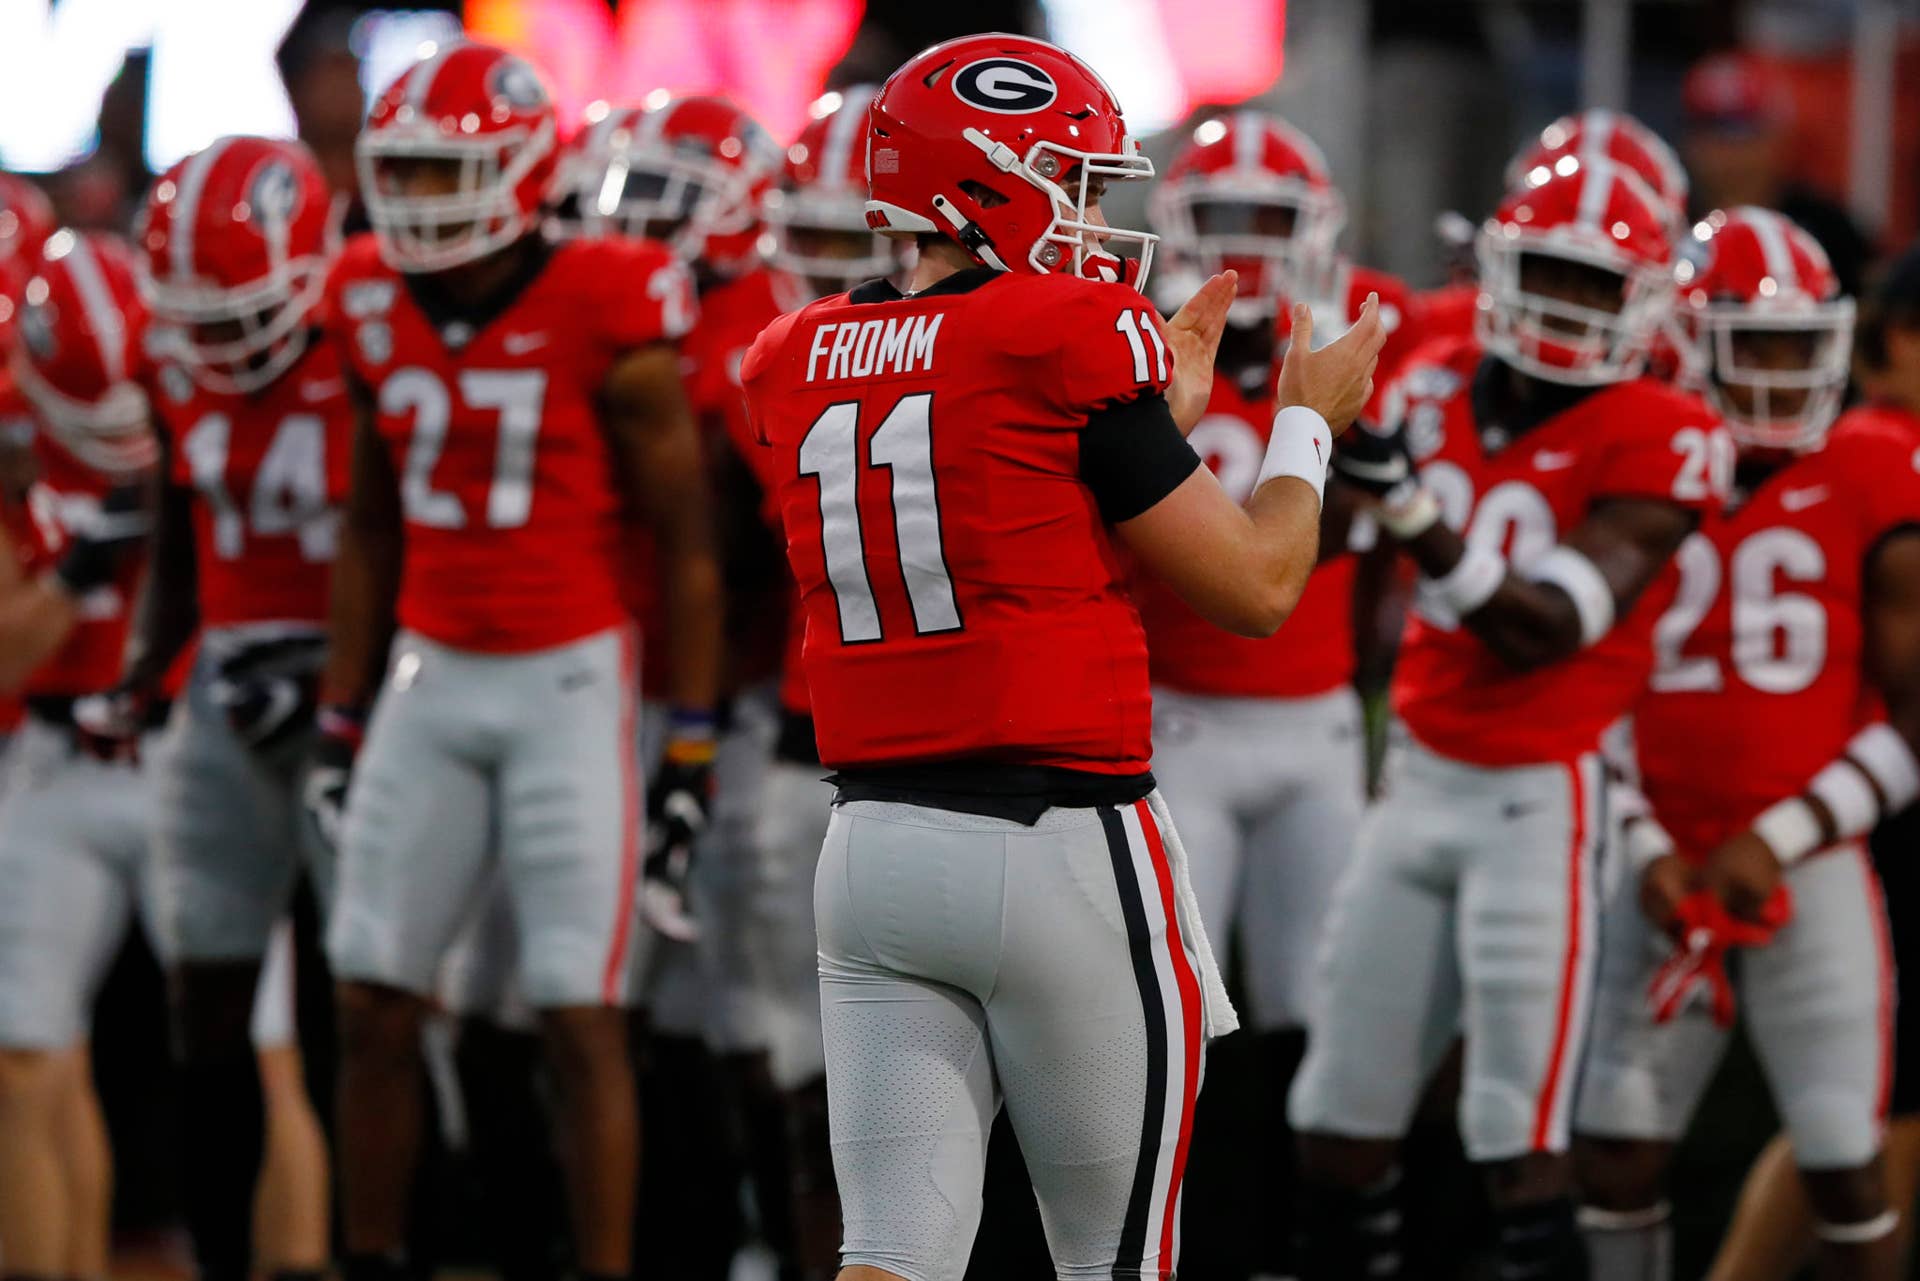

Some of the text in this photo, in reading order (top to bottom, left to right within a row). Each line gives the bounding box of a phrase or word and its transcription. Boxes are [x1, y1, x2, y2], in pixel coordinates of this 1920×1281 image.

[952, 57, 1058, 115] G
[805, 313, 945, 382] FROMM
[1115, 308, 1167, 383] 11
[184, 412, 341, 561] 14
[378, 365, 548, 530] 27
[798, 391, 964, 645] 11
[1650, 525, 1829, 694] 26
